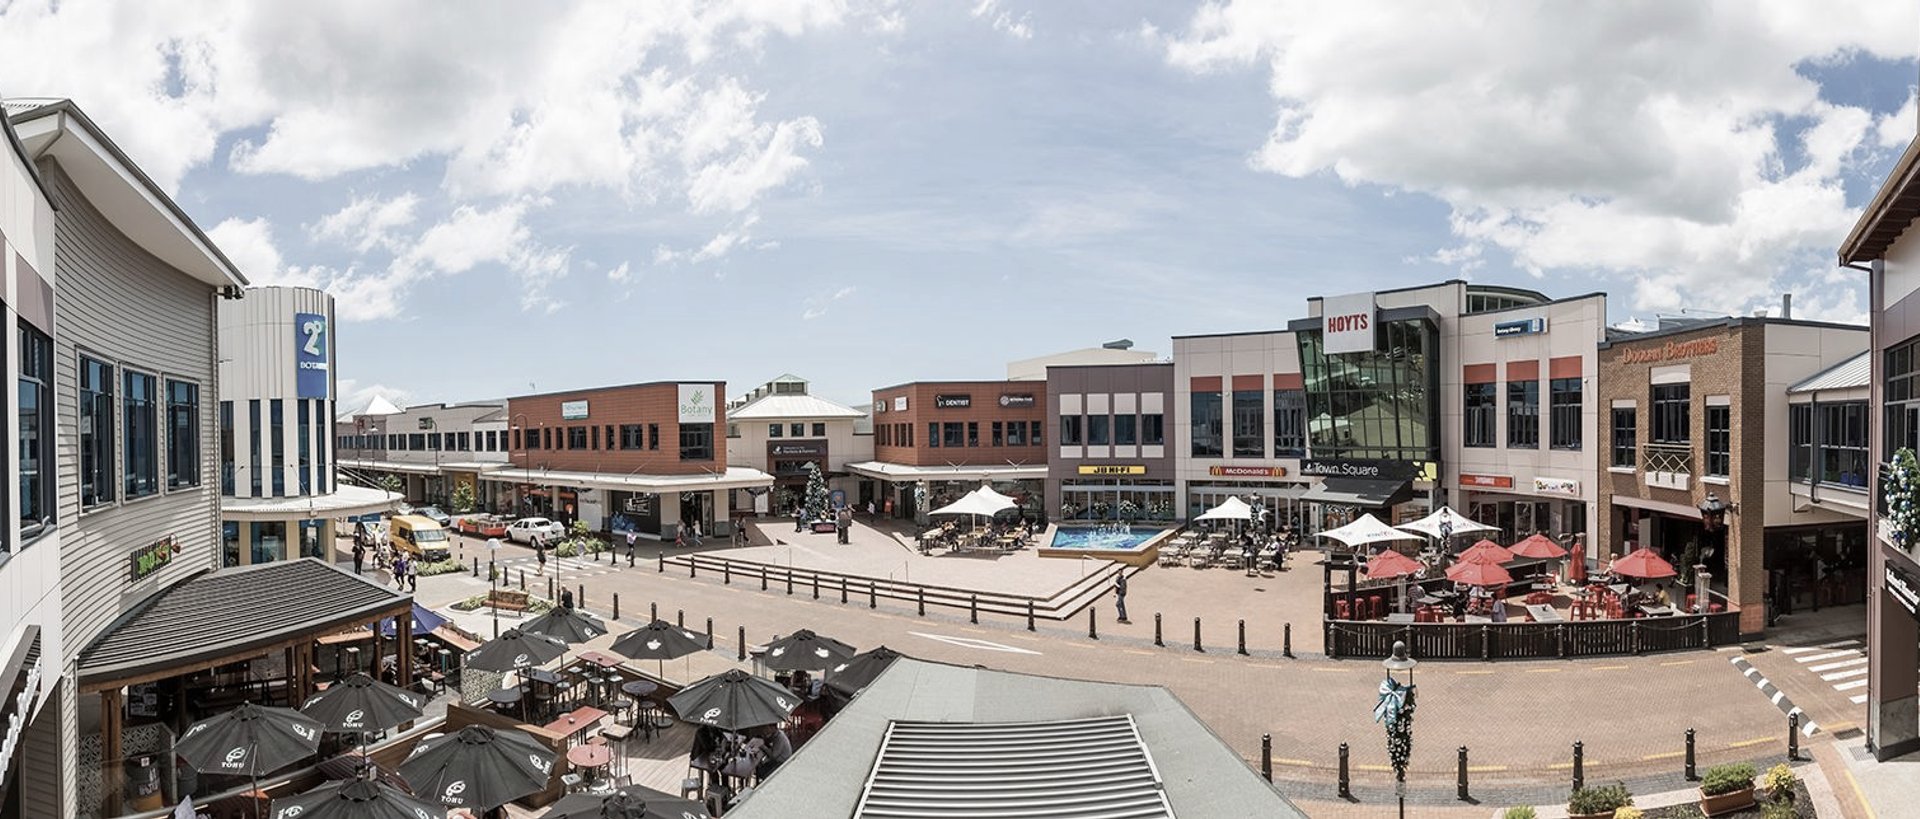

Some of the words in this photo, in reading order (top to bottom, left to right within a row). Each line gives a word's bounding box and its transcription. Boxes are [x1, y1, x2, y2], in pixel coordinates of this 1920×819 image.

[1328, 313, 1368, 333] HOYTS
[681, 404, 713, 415] Botany
[1314, 462, 1341, 474] Town
[1342, 463, 1379, 477] Square
